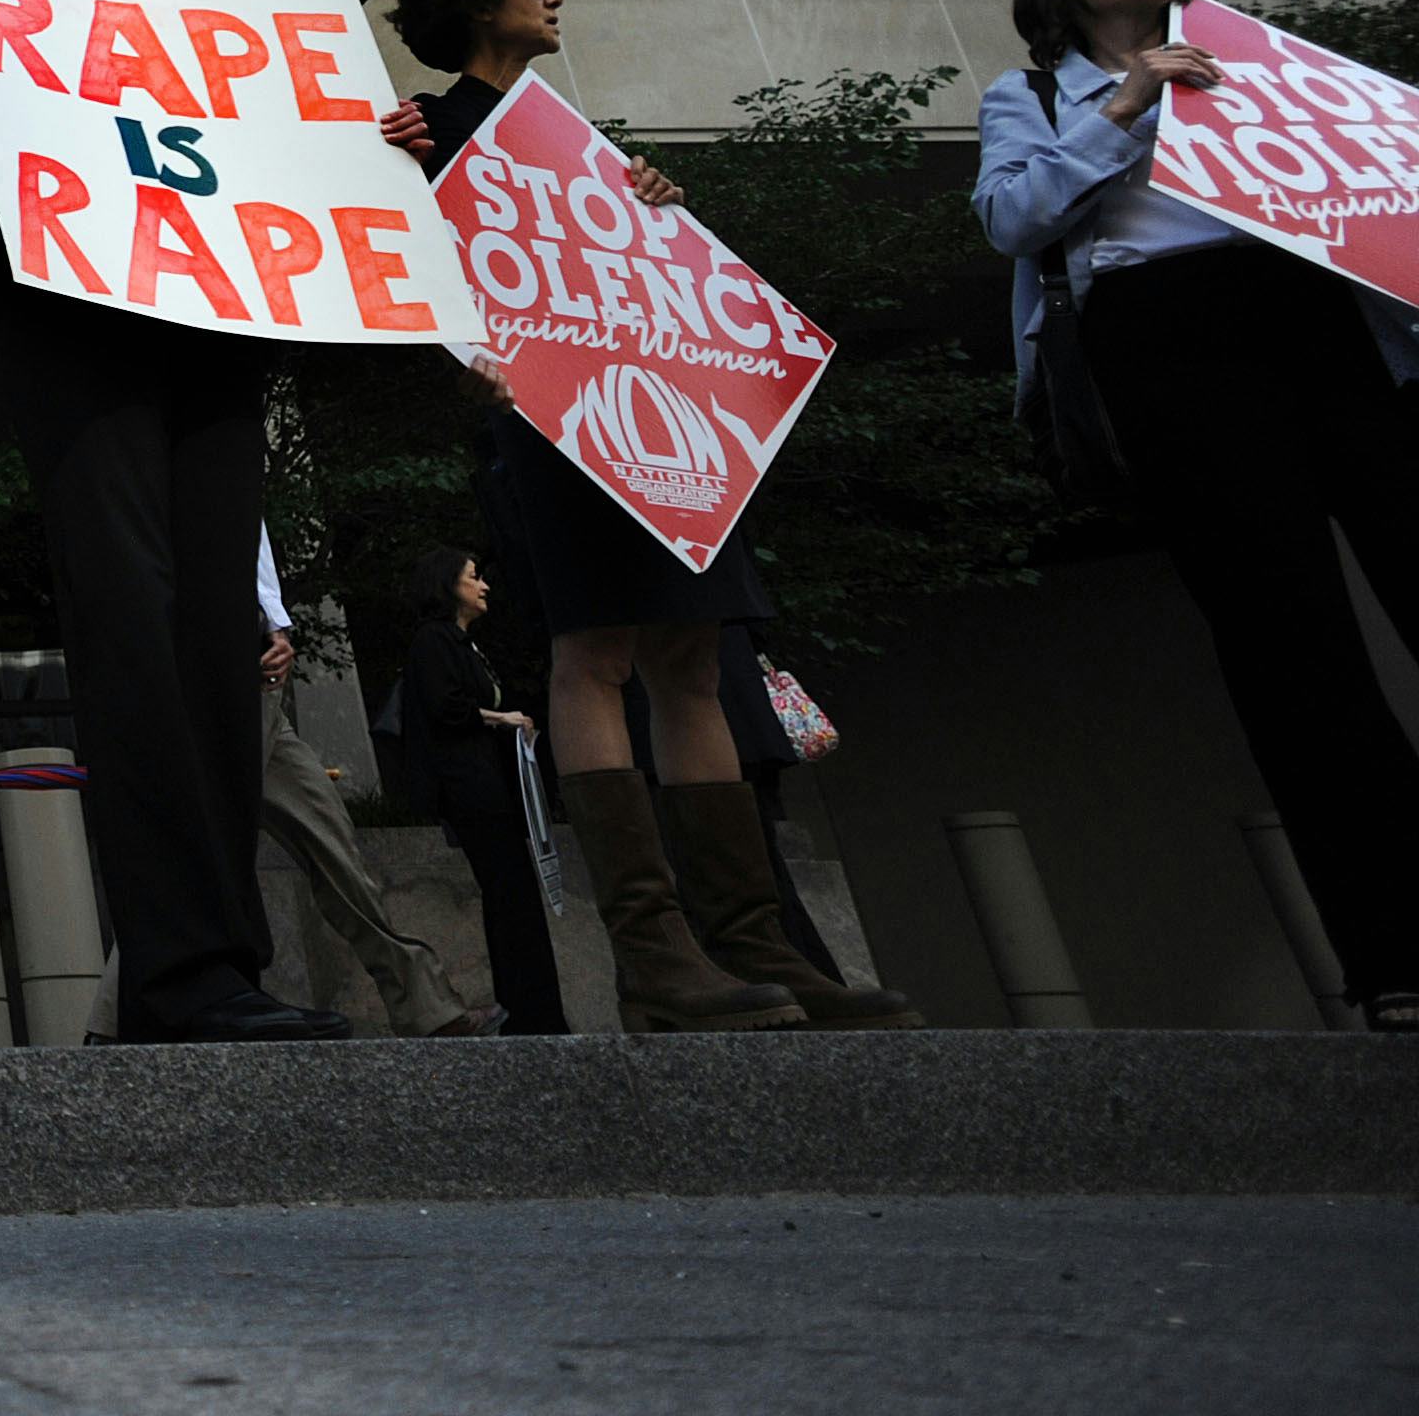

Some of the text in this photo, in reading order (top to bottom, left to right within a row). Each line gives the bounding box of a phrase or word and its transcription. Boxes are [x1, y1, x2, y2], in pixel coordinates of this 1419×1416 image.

[114, 116, 218, 197] IS
[1153, 124, 1419, 198] VIOLE
[17, 151, 440, 333] RAPE
[446, 217, 828, 360] OLENCE
[629, 315, 788, 379] Women
[584, 364, 729, 477] NOW
[613, 464, 727, 491] NATIONAL
